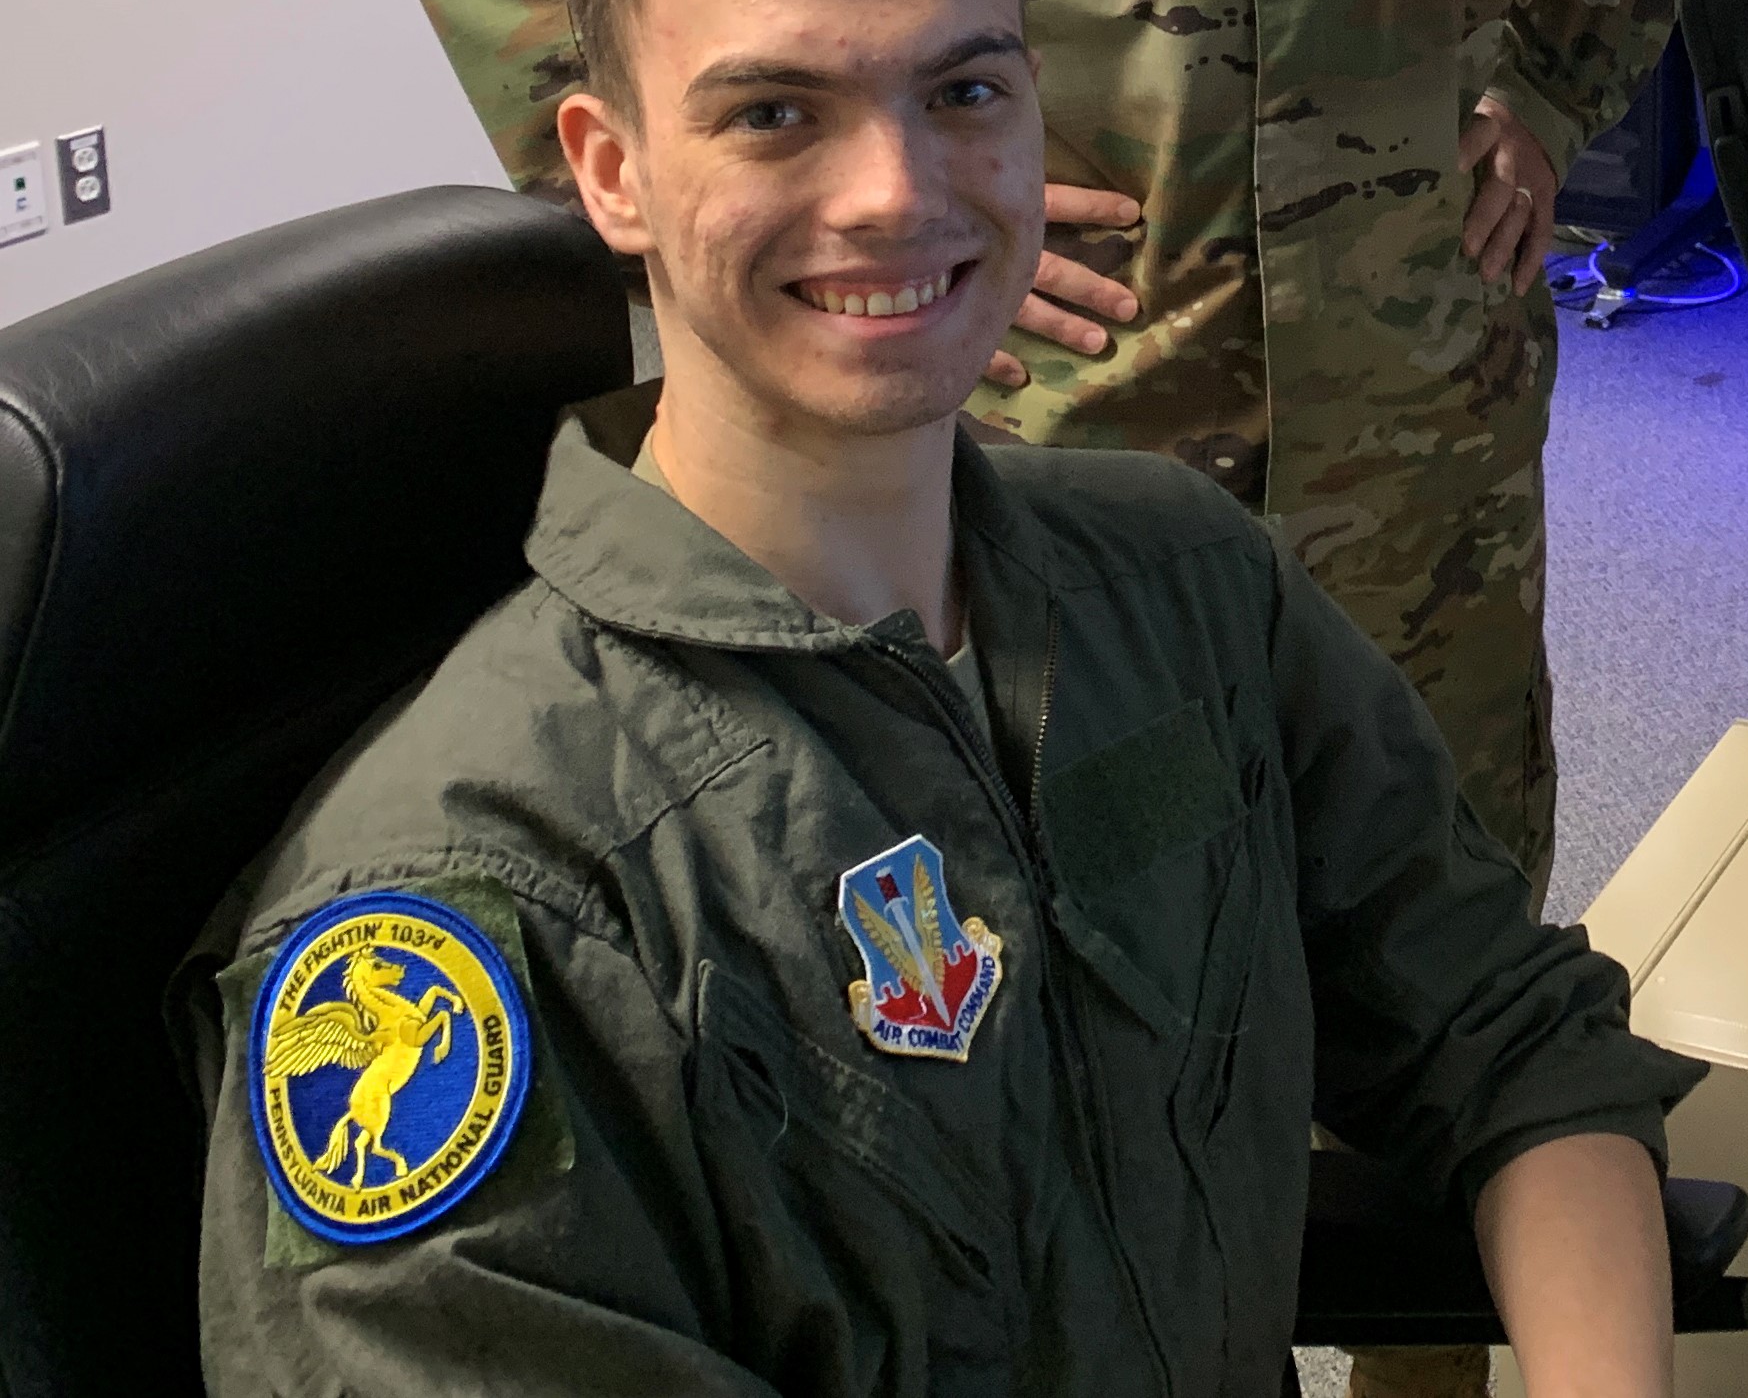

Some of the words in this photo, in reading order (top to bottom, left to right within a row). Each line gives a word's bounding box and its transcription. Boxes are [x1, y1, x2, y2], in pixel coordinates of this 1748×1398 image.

[278, 969, 306, 1015] THE
[305, 920, 385, 974] FIGHTIN'
[872, 1018, 903, 1046] AIR
[908, 1026, 965, 1052] COMBAT
[957, 954, 996, 1035] COMMAND
[269, 1086, 347, 1218] PENNSYLVANIA
[356, 1194, 392, 1219] AIR
[400, 1108, 495, 1205] NATIONAL
[482, 1013, 504, 1098] GUARD
